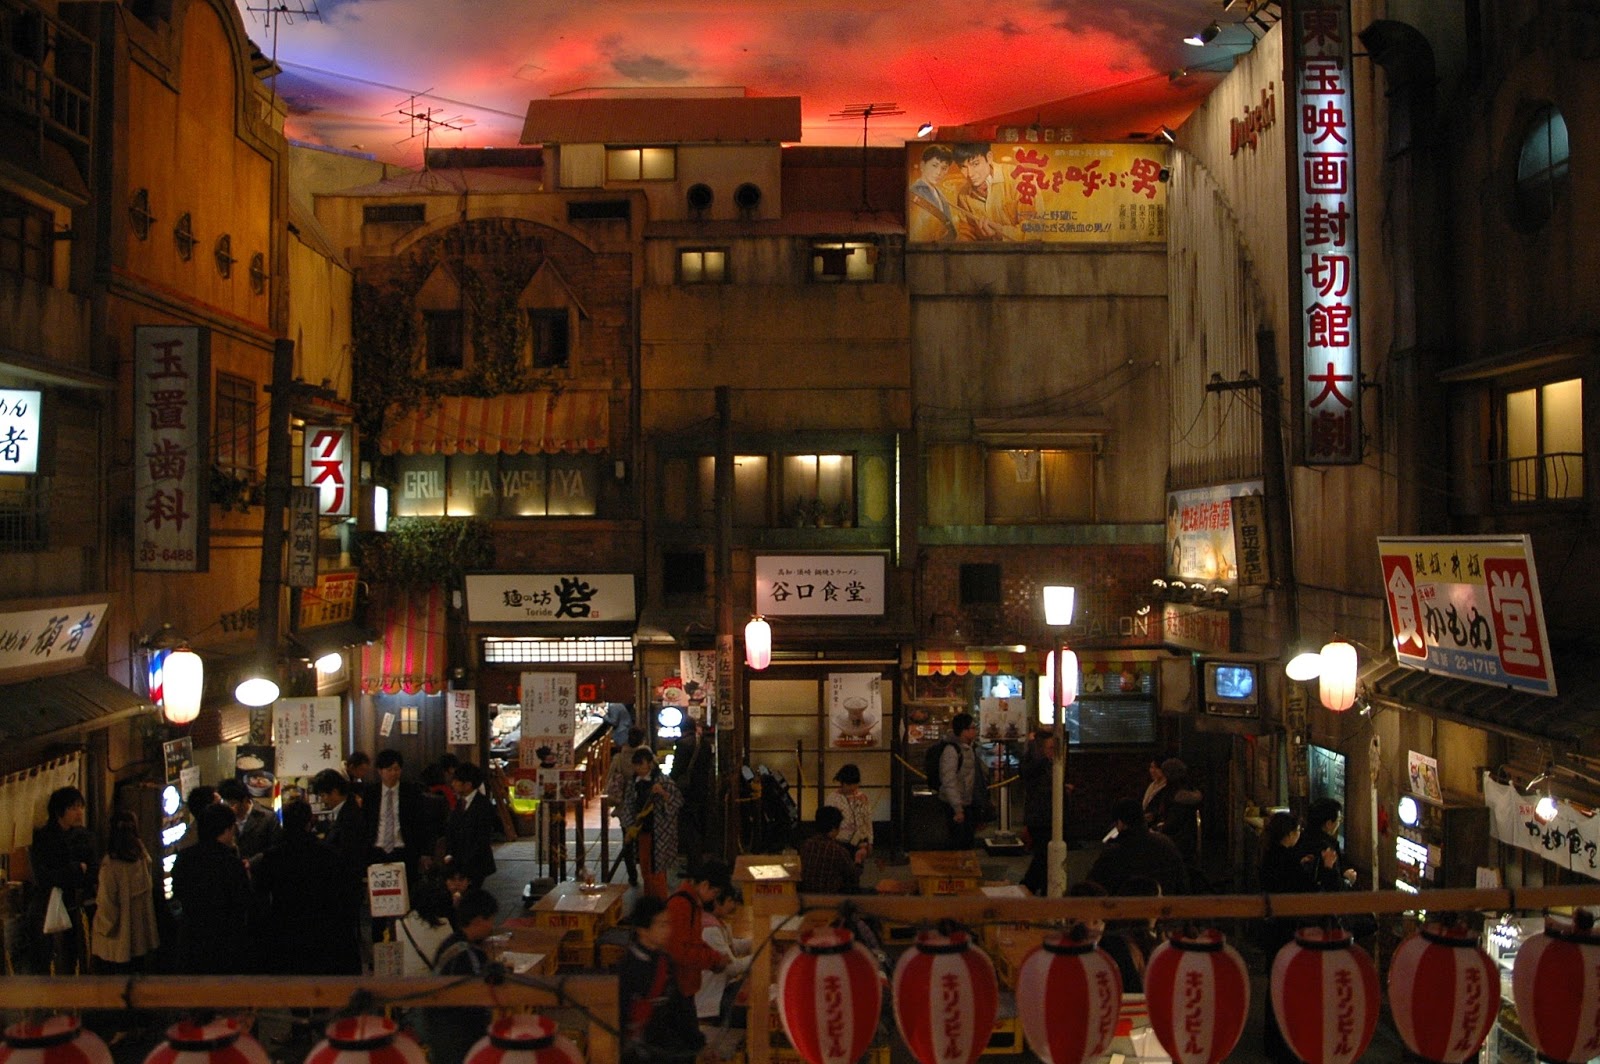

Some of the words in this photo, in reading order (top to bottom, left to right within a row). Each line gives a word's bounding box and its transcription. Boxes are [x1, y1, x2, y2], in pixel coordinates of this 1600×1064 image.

[1011, 149, 1161, 205] 嵐を呼ぶ男
[1300, 5, 1351, 347] 東宝映画封切館
[1308, 362, 1353, 457] 大劇
[145, 339, 190, 532] 玉置歯科
[1181, 500, 1232, 532] 地球防衛軍
[503, 589, 552, 607] 麺の坊
[771, 581, 865, 602] 谷口食堂
[525, 608, 553, 617] Toride
[1424, 602, 1492, 650] かもめ
[1454, 654, 1497, 676] 23-1715
[318, 719, 334, 759] 頑者
